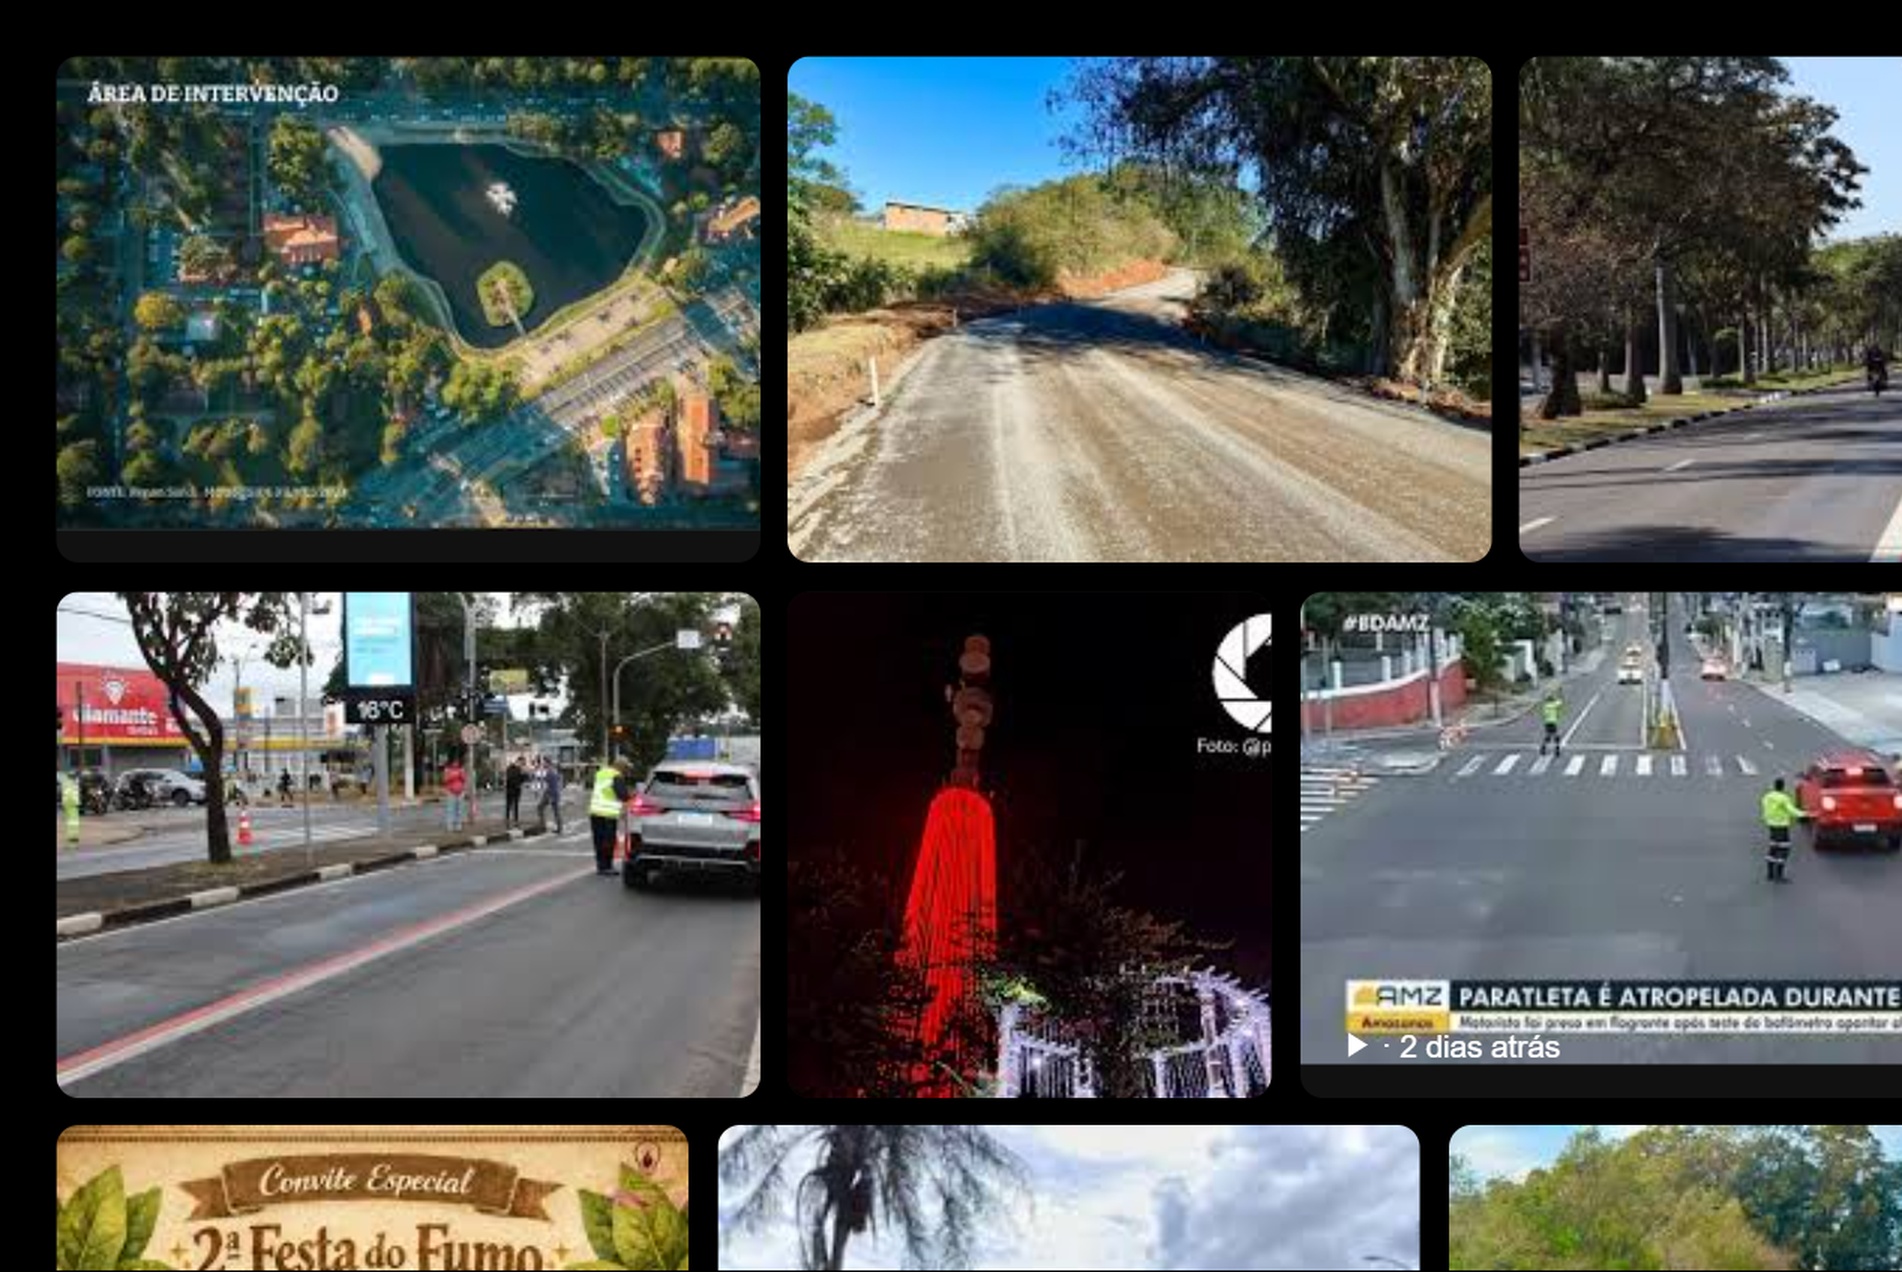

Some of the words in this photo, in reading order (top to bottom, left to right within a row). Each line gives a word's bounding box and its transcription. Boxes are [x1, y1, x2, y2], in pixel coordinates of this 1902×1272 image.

[260, 1163, 358, 1196] Convite
[366, 1162, 476, 1201] Especial
[249, 1223, 359, 1271] Festa
[365, 1231, 406, 1269] do
[415, 1223, 544, 1271] Fumo
